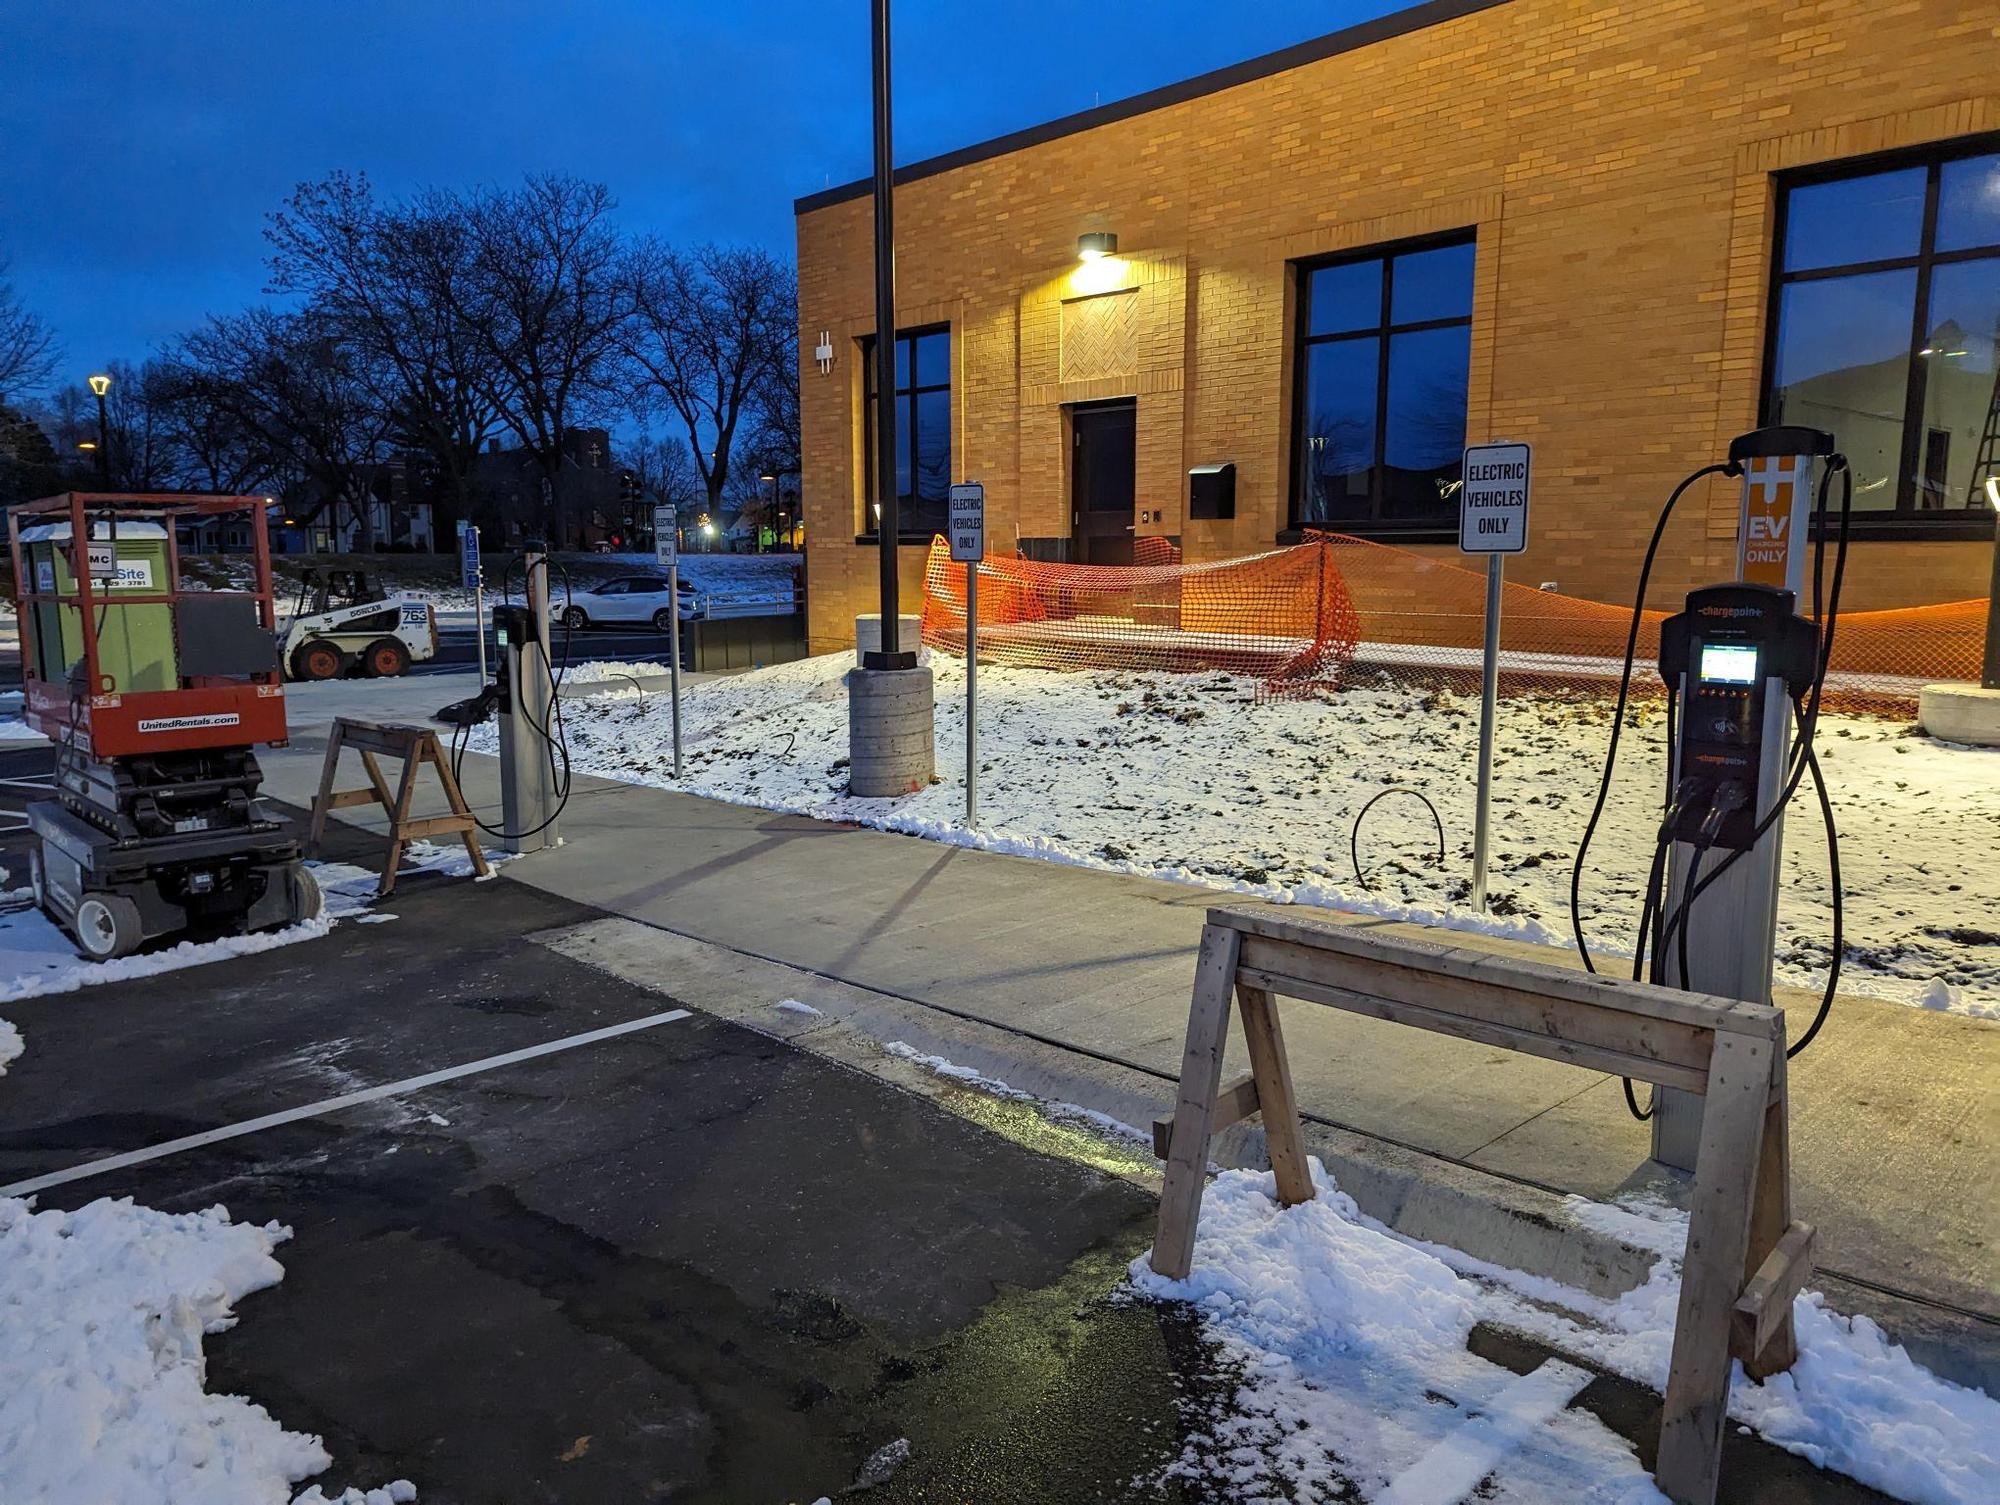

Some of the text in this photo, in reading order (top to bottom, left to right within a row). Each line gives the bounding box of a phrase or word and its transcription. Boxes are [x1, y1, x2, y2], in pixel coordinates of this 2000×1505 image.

[1469, 463, 1525, 481] ELECTRIC
[953, 498, 981, 511] ELECTRIC
[1468, 490, 1523, 508] VEHICLES
[953, 517, 981, 529] VEHICLES
[1478, 517, 1509, 534] ONLY
[1749, 516, 1789, 539] EV
[959, 536, 976, 549] ONLY
[1746, 550, 1786, 563] ONLY
[117, 568, 145, 580] Site
[402, 610, 427, 621] 763
[141, 715, 238, 731] UnitedRentals.com
